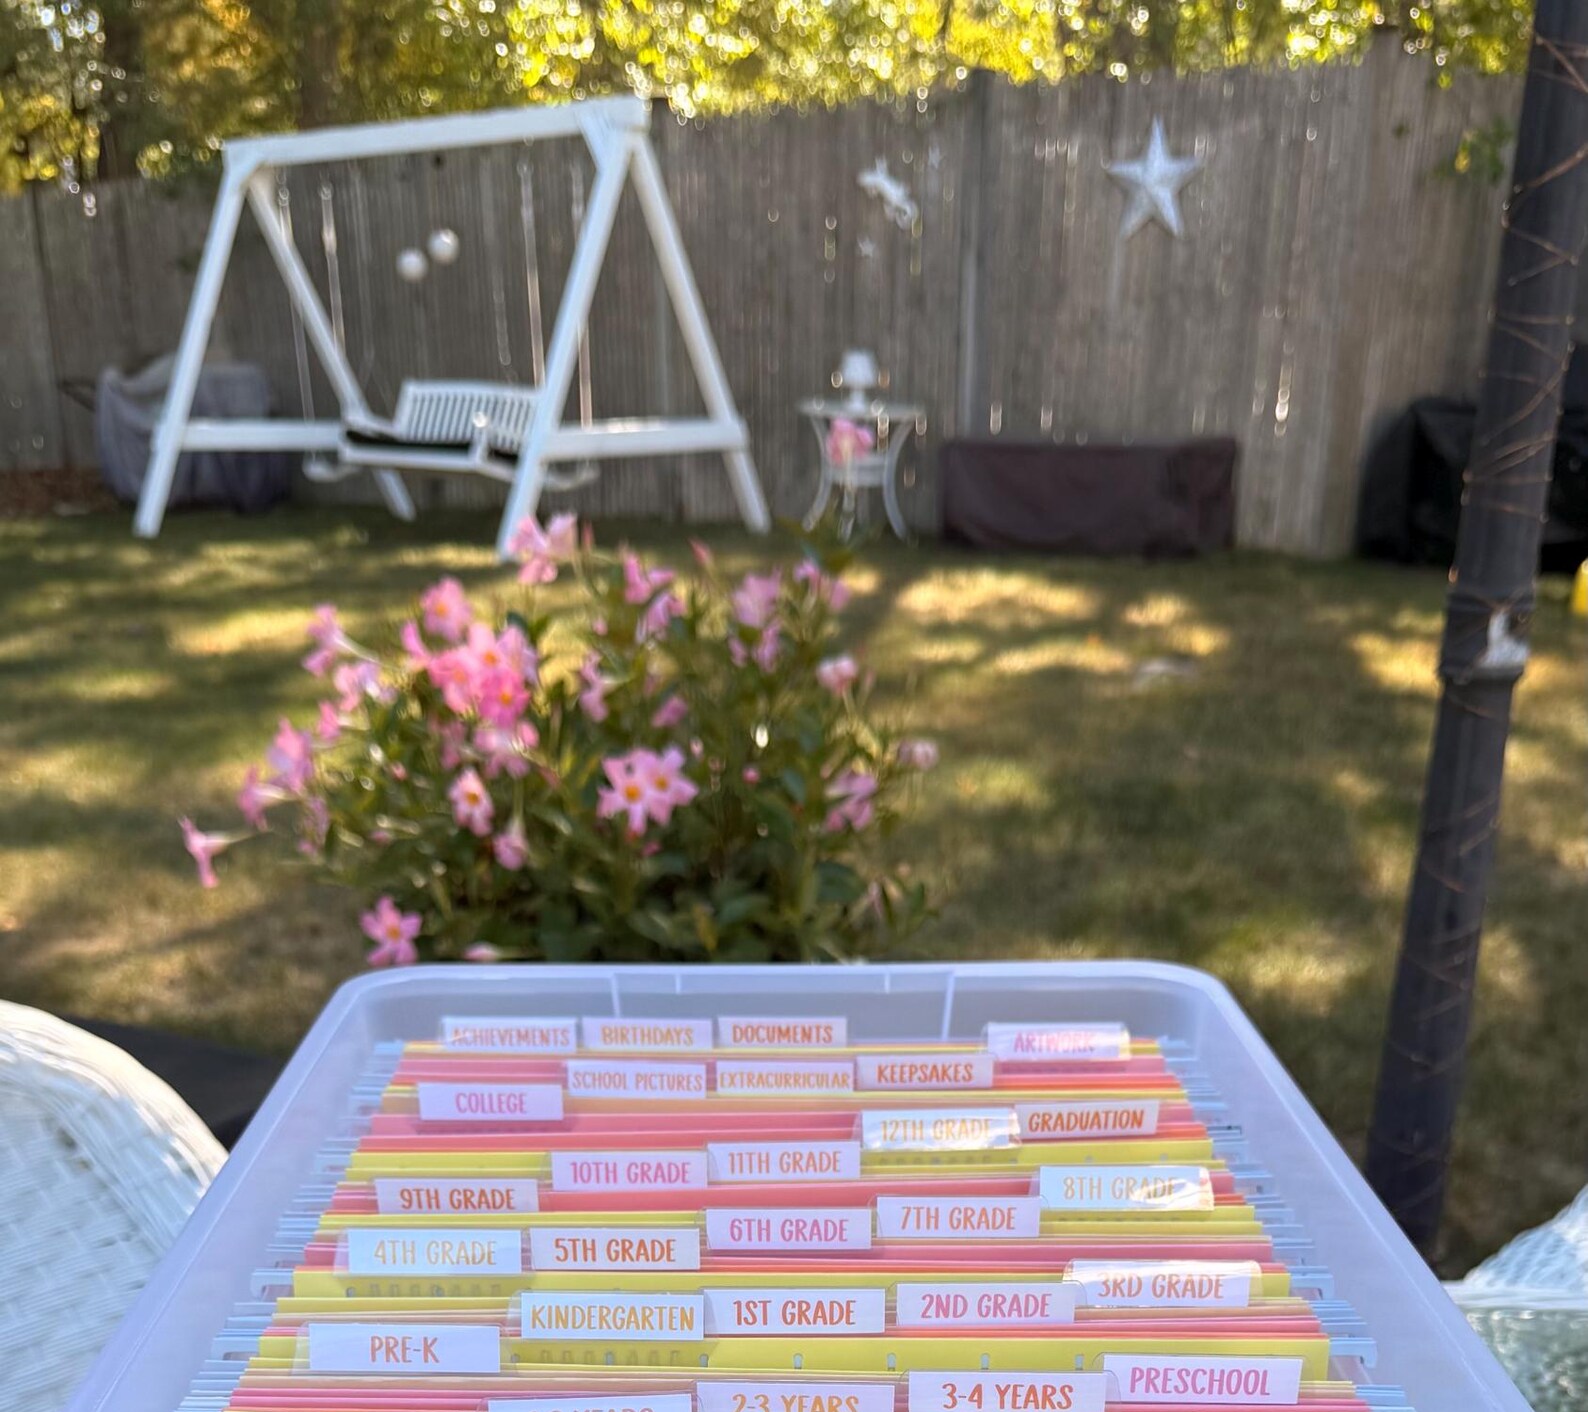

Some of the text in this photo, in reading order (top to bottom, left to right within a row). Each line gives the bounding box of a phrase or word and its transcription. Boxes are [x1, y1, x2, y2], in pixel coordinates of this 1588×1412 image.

[451, 1027, 570, 1047] ACHIEVEMENTS
[602, 1026, 694, 1045] BIRTHDAYS
[732, 1024, 833, 1044] DOCUMENTS
[572, 1072, 703, 1092] SCHOOL PICTURES
[719, 1072, 851, 1090] EXTRACURRICULAR
[877, 1063, 974, 1084] KEEPSAKES
[455, 1092, 528, 1114] COLLEGE
[880, 1119, 924, 1142] 12TH
[1028, 1109, 1144, 1133] GRADUATION
[570, 1161, 692, 1185] 10TH GRADE
[728, 1150, 842, 1175] 11TH GRADE
[400, 1188, 516, 1211] 9TH GRADE
[1063, 1176, 1177, 1200] 8TH GRADE
[729, 1218, 849, 1243] 6TH GRADE
[901, 1206, 1018, 1231] 7TH GRADE
[374, 1240, 497, 1266] 4TH GRADE
[554, 1238, 677, 1263] 5TH GRADE
[1098, 1272, 1225, 1299] 3RD GRADE
[733, 1300, 856, 1326] 1ST GRADE
[921, 1293, 1052, 1319] 2ND GRADE
[531, 1305, 695, 1332] KINDERGARTEN
[370, 1335, 440, 1364] PRE-K
[1129, 1366, 1271, 1396] PRESCHOOL
[943, 1382, 1074, 1411] 3-4 YEARS
